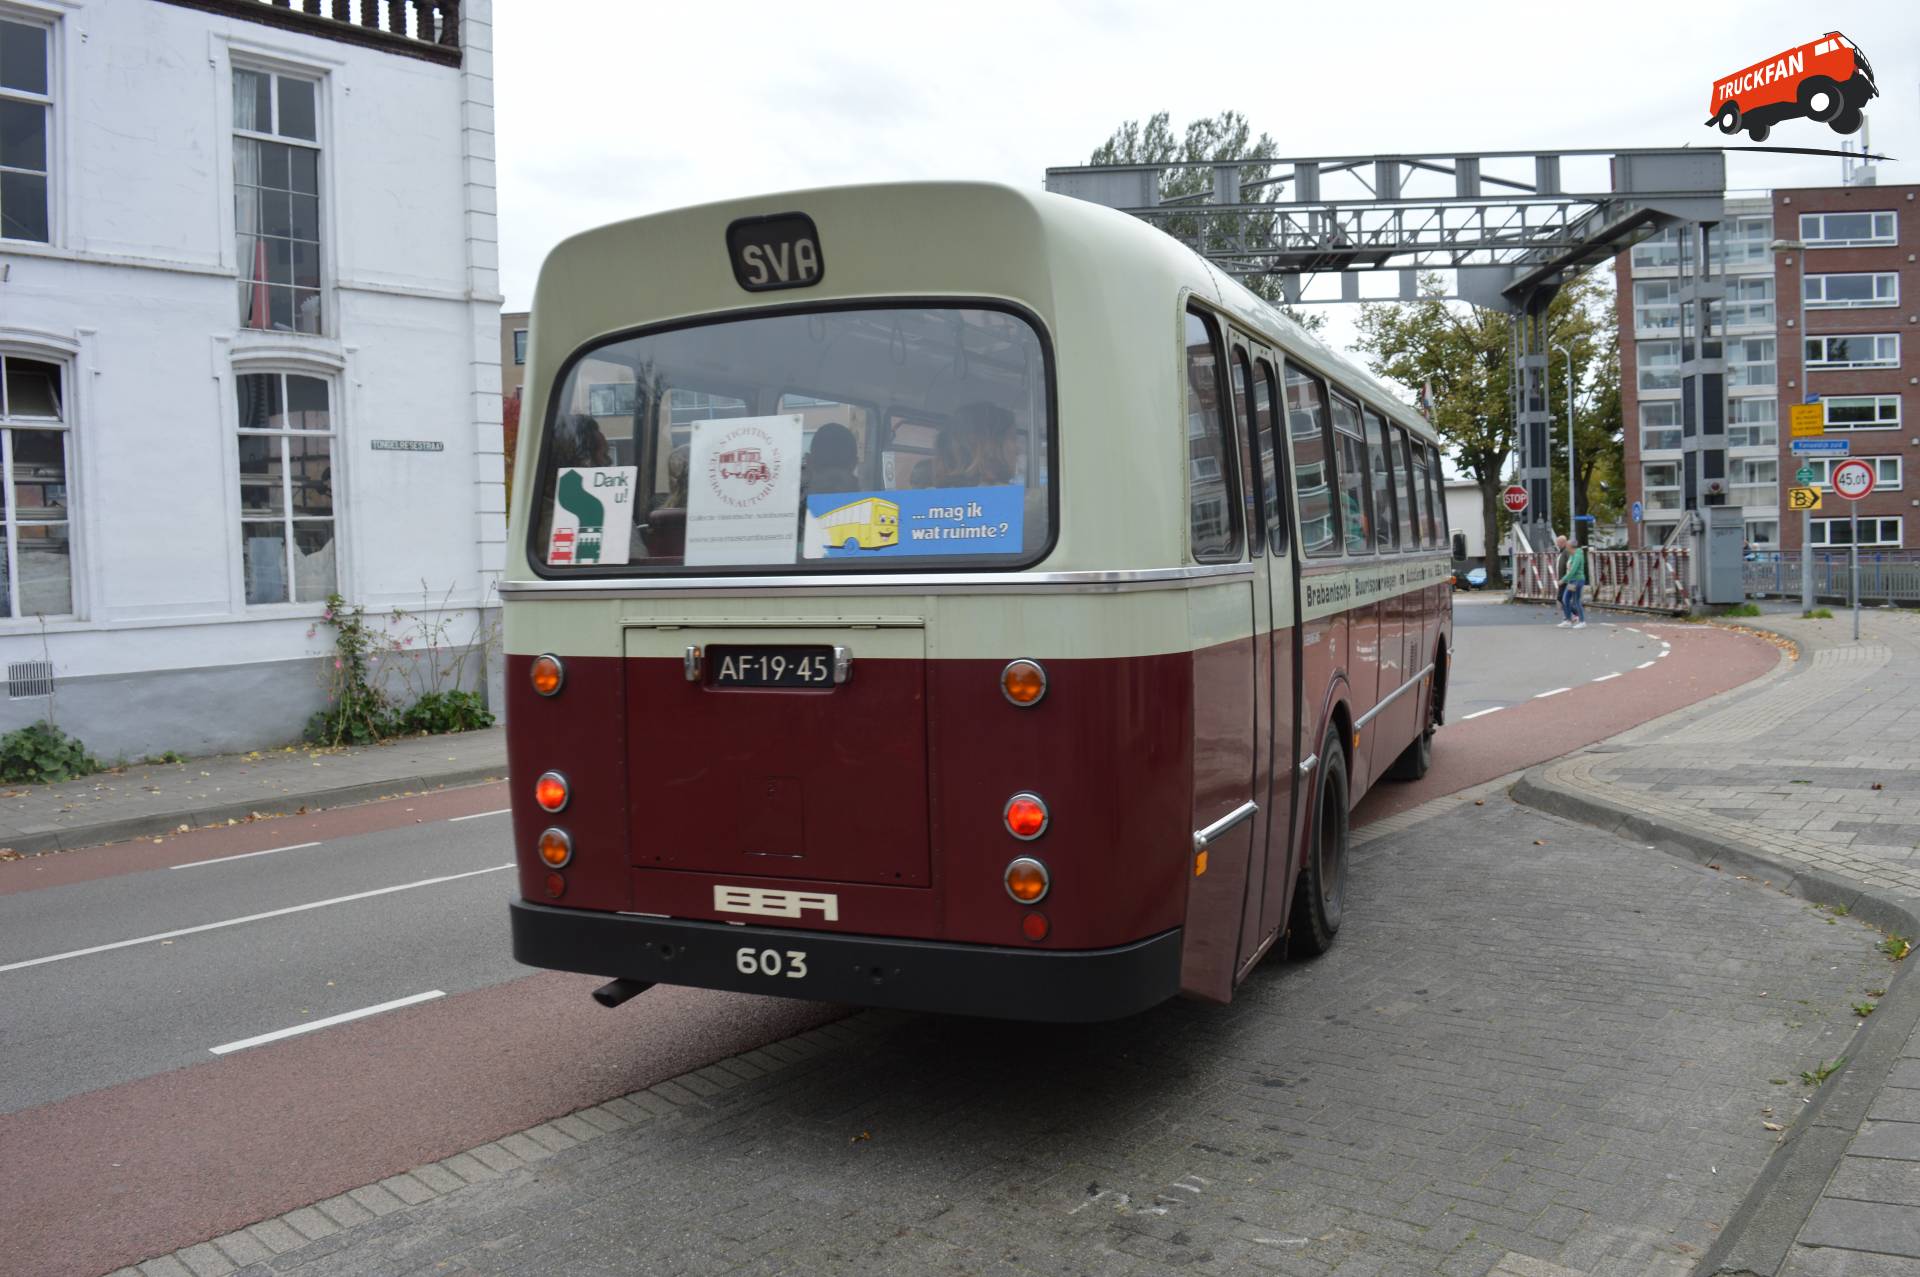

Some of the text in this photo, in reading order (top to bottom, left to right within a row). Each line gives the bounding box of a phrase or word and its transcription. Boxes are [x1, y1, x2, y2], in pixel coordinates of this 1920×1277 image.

[743, 238, 819, 284] SVA
[593, 471, 628, 488] Dank
[614, 488, 628, 503] u!
[1505, 494, 1527, 503] STOP
[1795, 491, 1806, 506] B
[928, 507, 963, 521] mag
[967, 502, 983, 517] ik
[912, 528, 940, 539] wat
[718, 656, 829, 681] AF-19-45
[736, 947, 808, 979] 603
